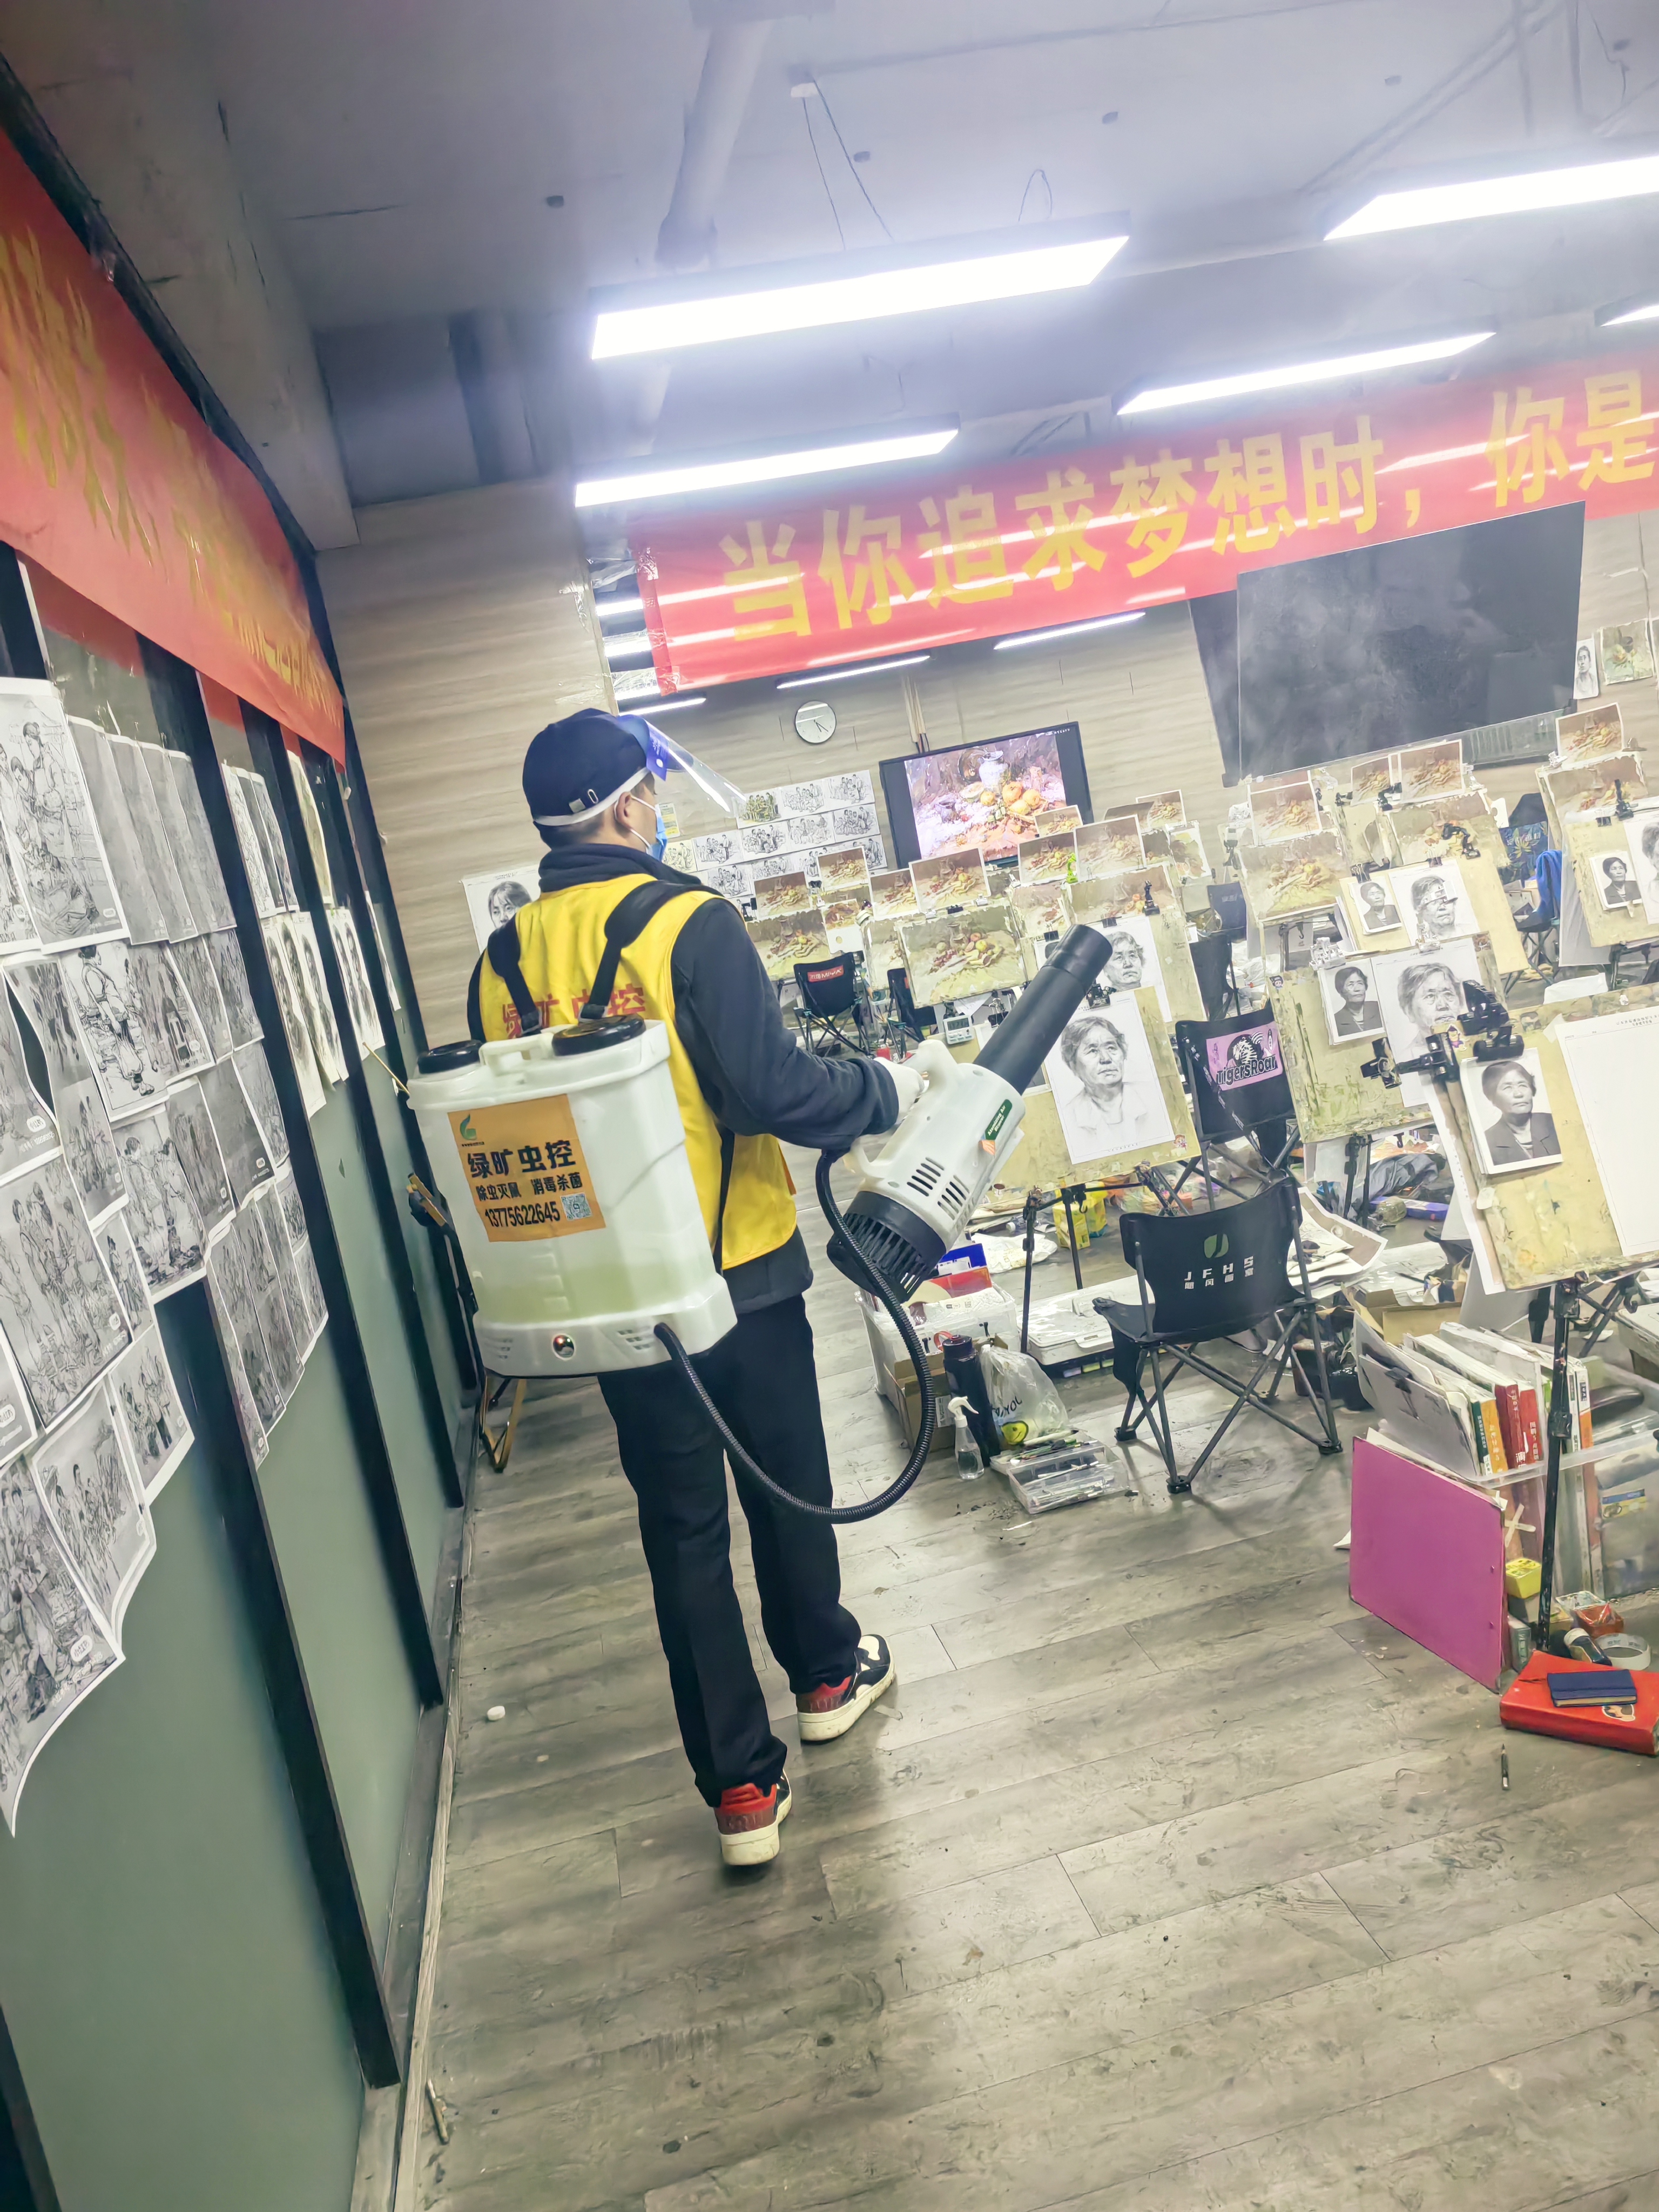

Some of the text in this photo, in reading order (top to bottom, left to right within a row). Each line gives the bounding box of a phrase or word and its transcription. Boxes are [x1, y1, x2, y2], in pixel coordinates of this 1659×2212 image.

[530, 1172, 583, 1196] 消毒杀菌
[485, 1201, 561, 1228] 13775622645
